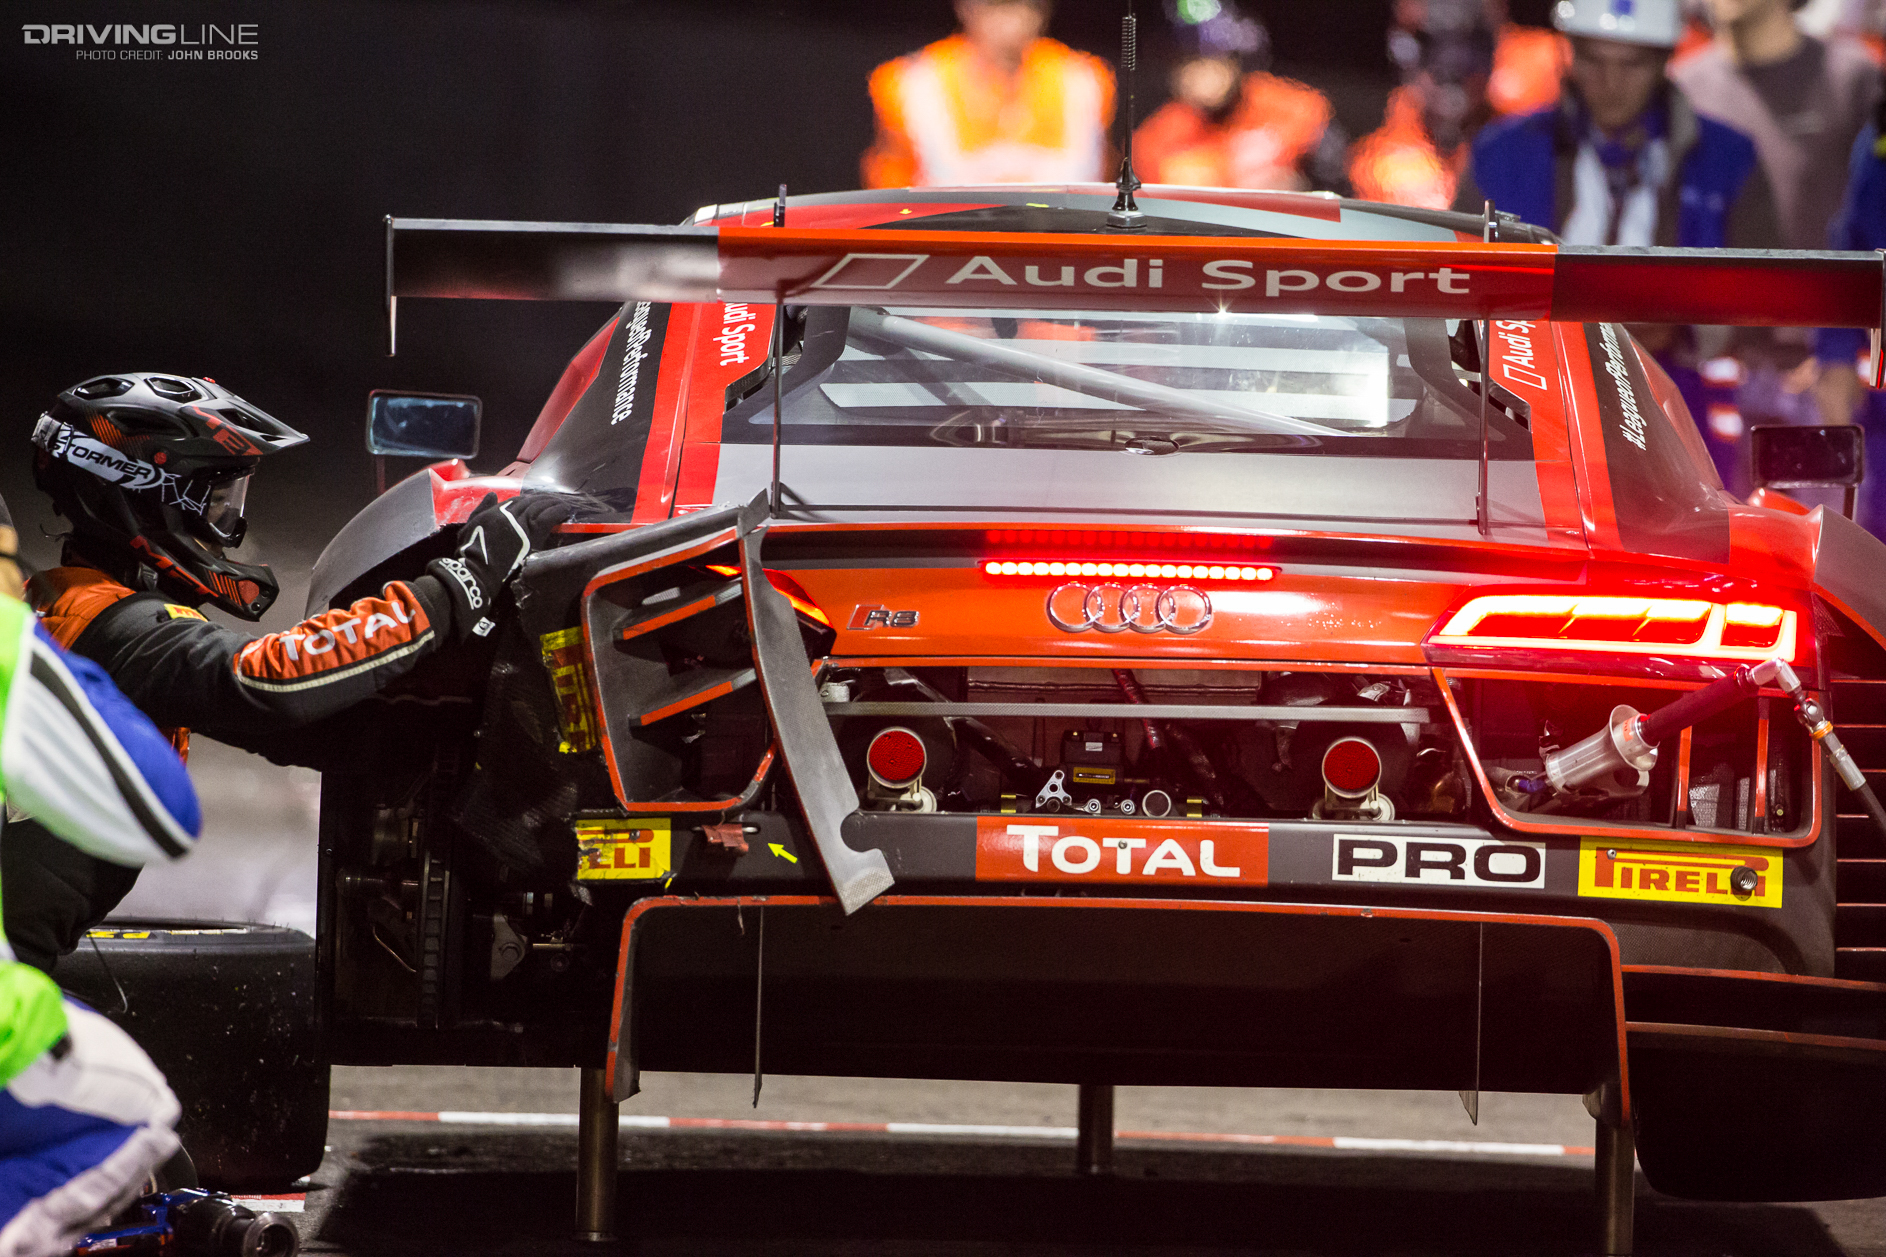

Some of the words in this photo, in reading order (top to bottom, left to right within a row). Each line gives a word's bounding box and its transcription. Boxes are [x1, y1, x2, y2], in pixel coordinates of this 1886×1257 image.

[945, 255, 1164, 288] Audi
[1202, 259, 1471, 297] Sport
[722, 303, 757, 325] udi
[713, 323, 756, 366] Sport
[1498, 331, 1536, 369] Audi
[279, 601, 416, 661] TOTAL
[864, 610, 919, 628] R8
[1006, 824, 1241, 877] TOTAL
[1337, 839, 1541, 883] PRO
